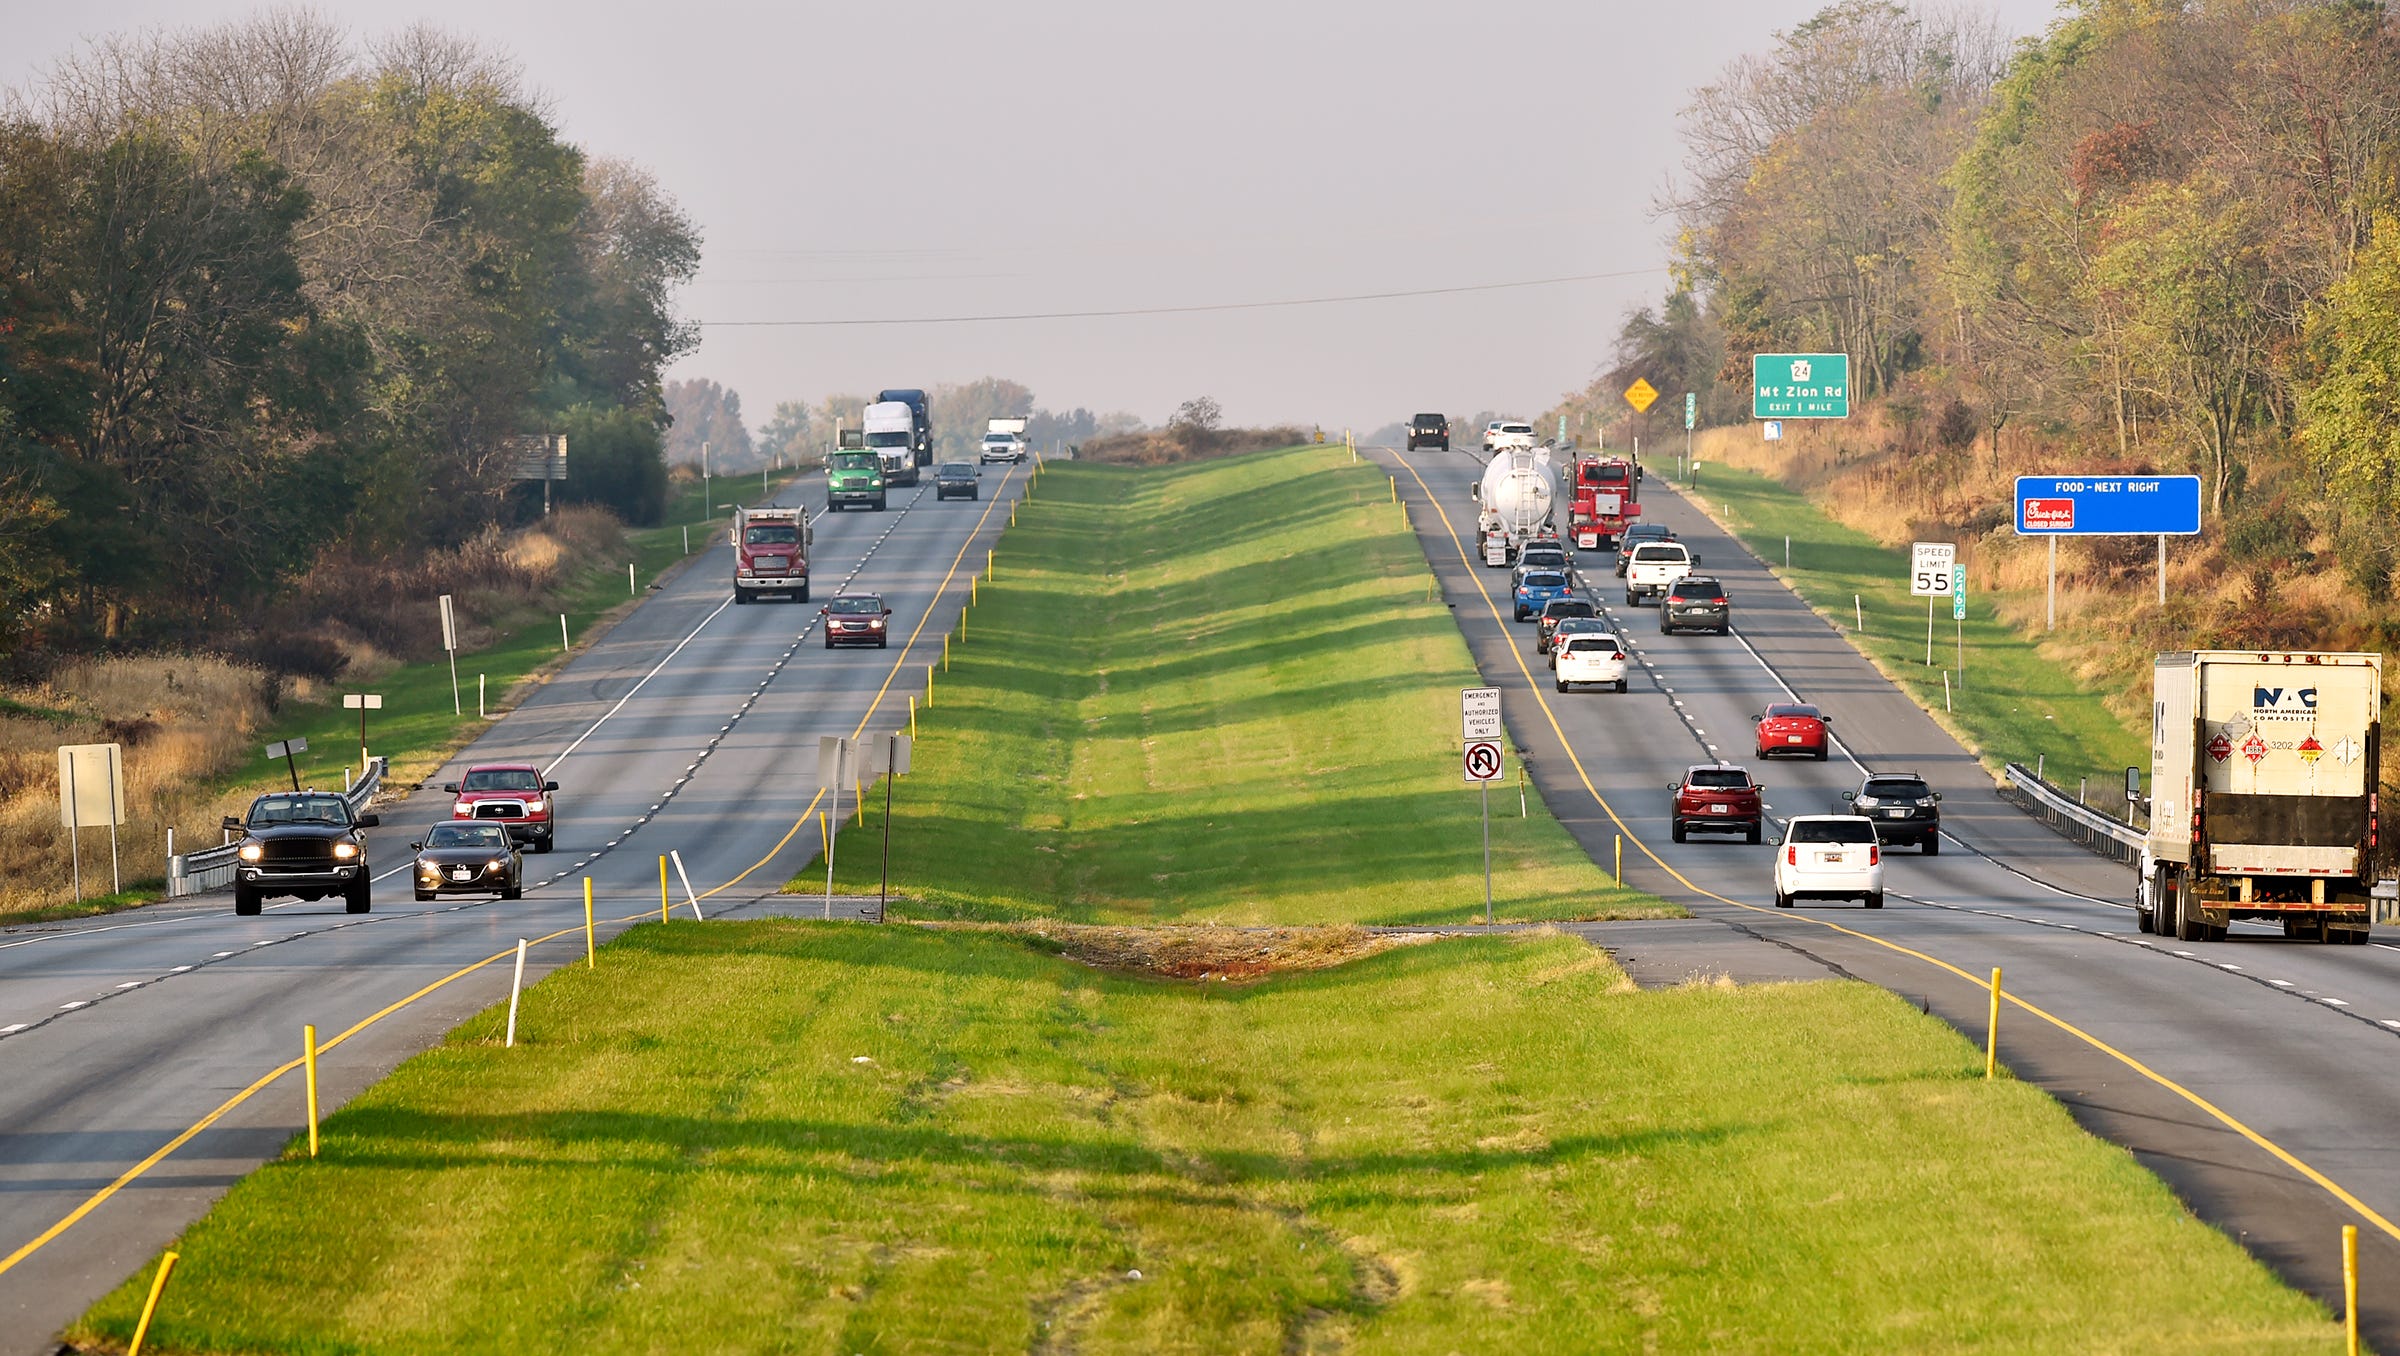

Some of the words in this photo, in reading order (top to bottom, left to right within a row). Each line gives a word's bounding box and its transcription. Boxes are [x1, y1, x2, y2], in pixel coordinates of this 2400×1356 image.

[1794, 366, 1808, 377] 24
[1760, 386, 1779, 397] Mt
[1786, 386, 1818, 397] Zion
[1825, 386, 1842, 397] Rd
[1769, 403, 1791, 411] EXIT
[1798, 402, 1802, 412] 1
[1808, 403, 1832, 411] MILE
[2128, 482, 2160, 493] RIGHT
[2026, 520, 2049, 528] CLOSED
[2050, 520, 2072, 528] SUNDAY
[1917, 548, 1952, 557] SPEED
[1920, 560, 1946, 568] LIMIT
[1917, 572, 1948, 591] 55
[1464, 692, 1497, 700] EMERGENCY
[2254, 687, 2317, 707] NAC
[1469, 718, 1495, 726] VEHICLES
[2271, 740, 2293, 750] 3202
